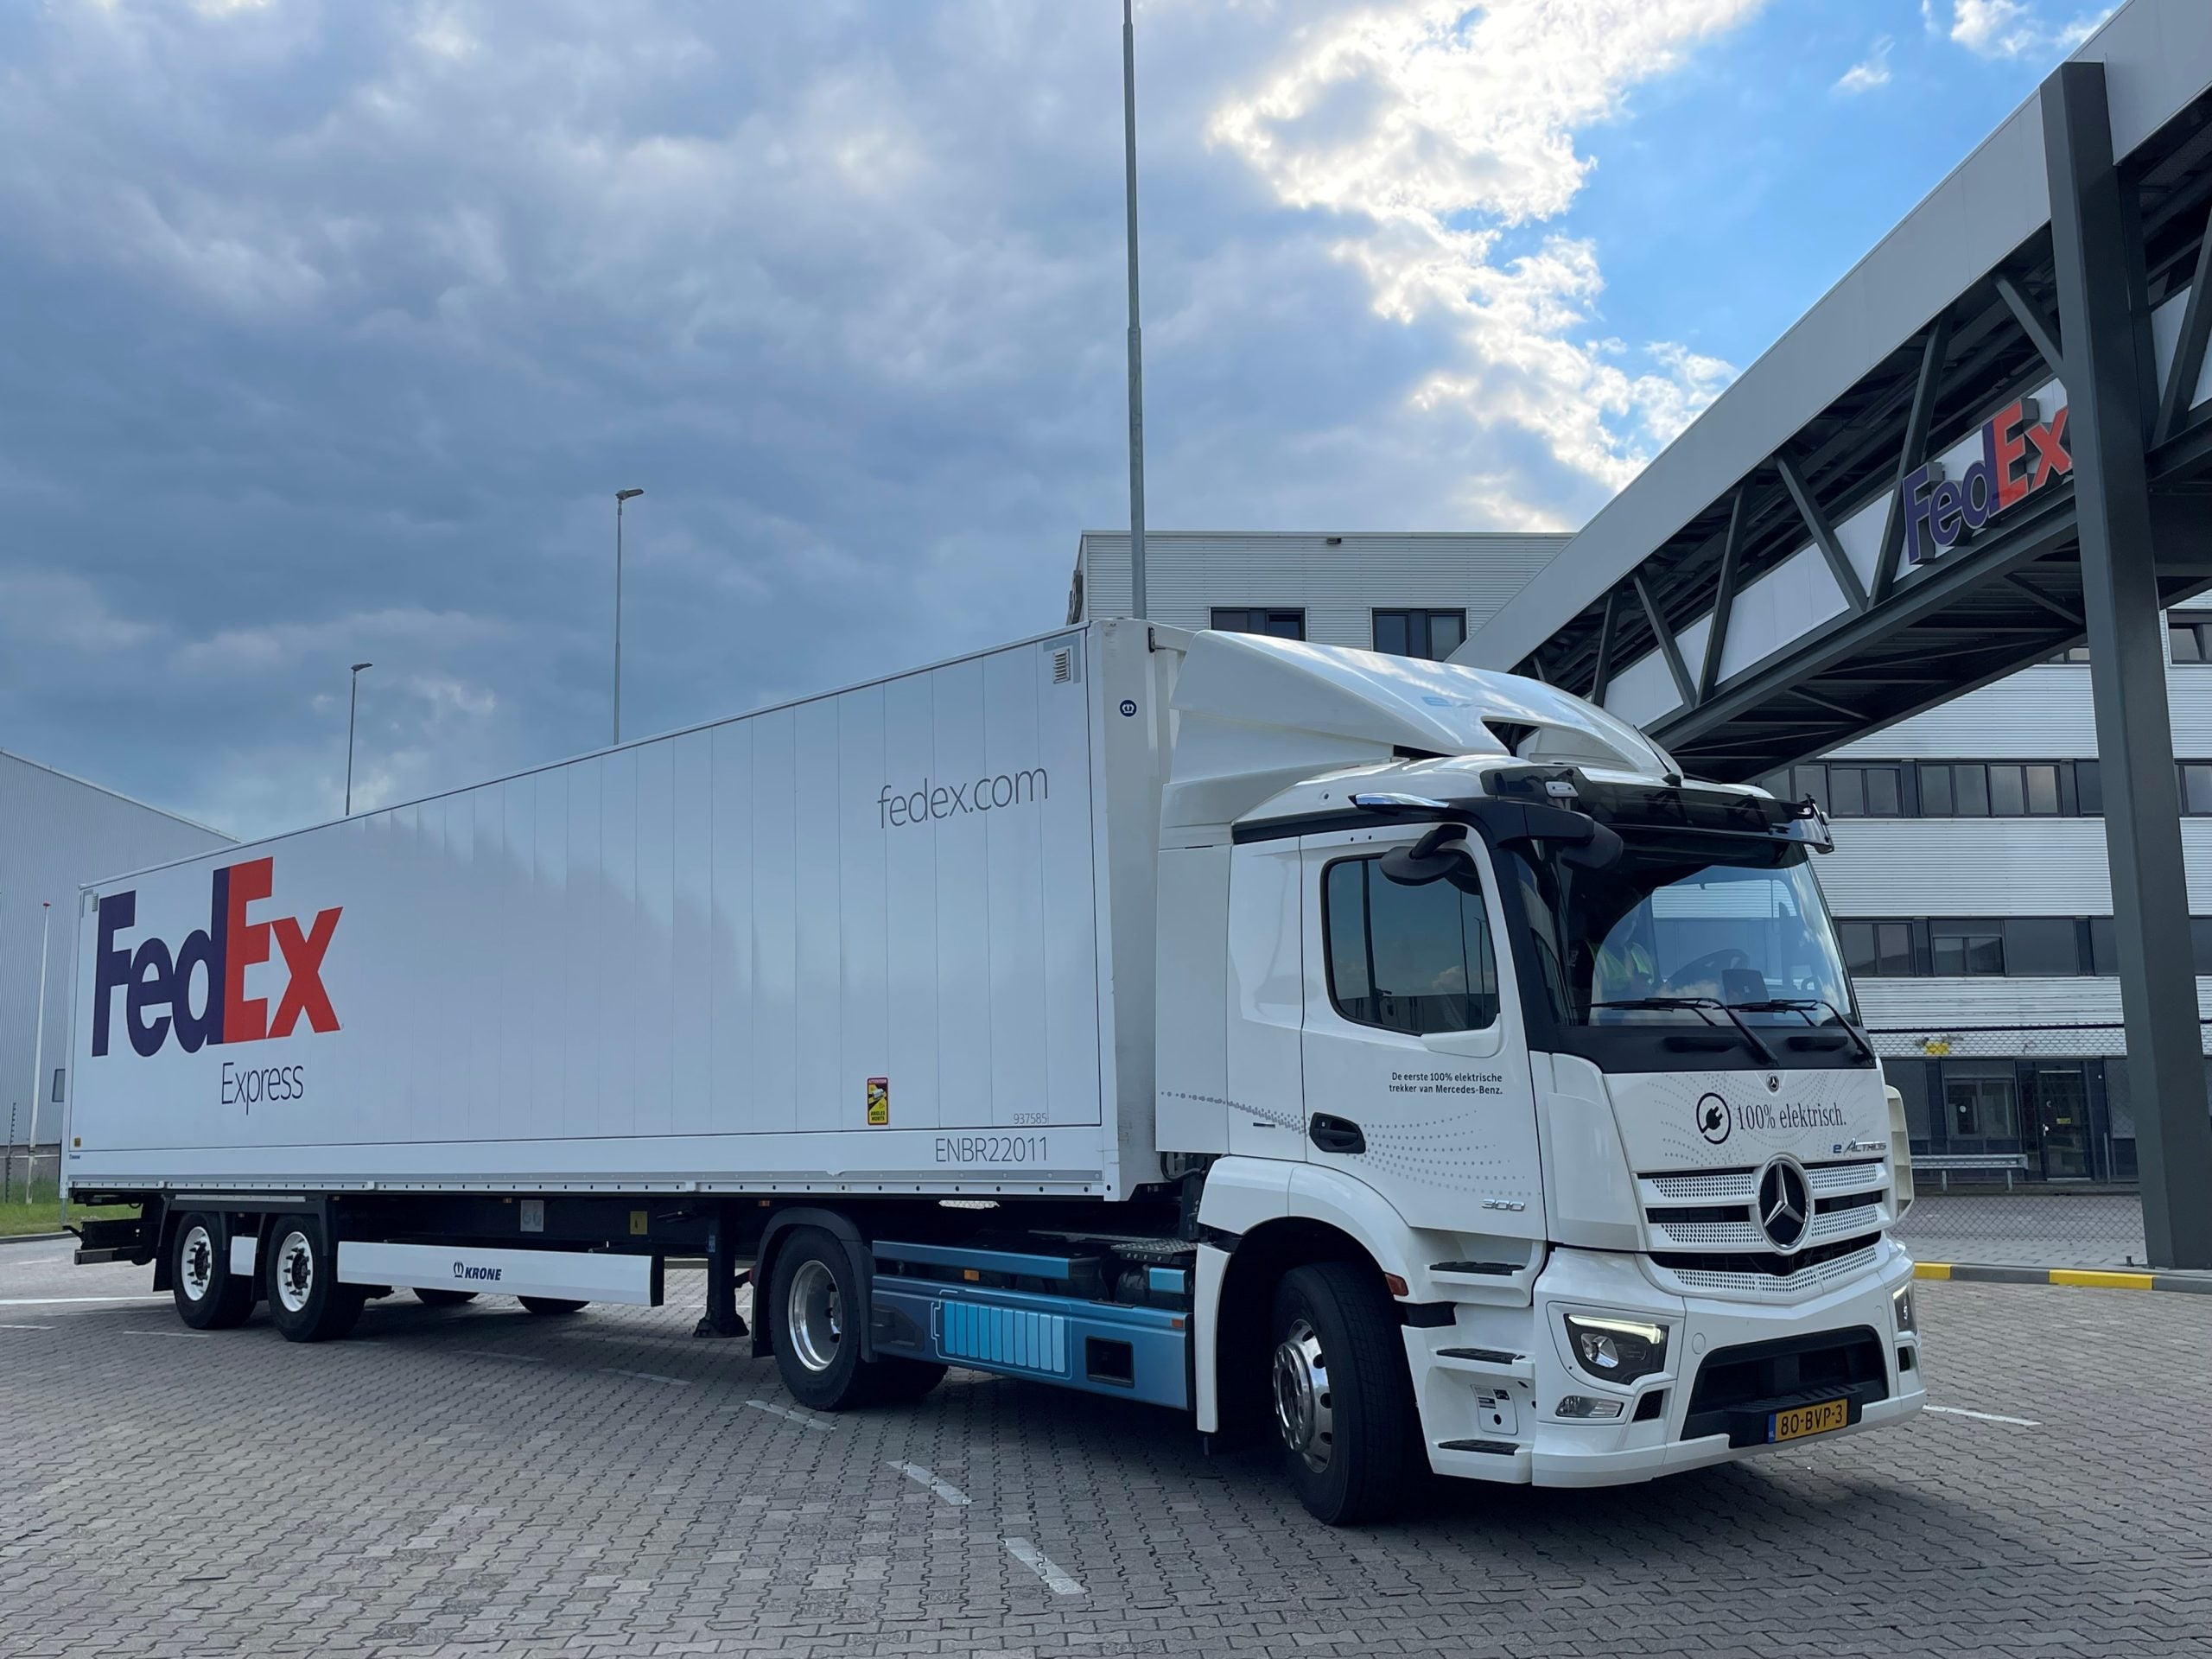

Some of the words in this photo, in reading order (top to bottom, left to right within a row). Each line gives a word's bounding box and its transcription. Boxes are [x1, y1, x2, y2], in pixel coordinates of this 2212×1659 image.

[1903, 400, 2072, 564] FedEx
[877, 768, 1048, 830] fedex.com
[92, 856, 343, 1057] FedEx
[221, 1062, 303, 1116] Express
[1389, 1084, 1417, 1093] trekker
[1435, 1084, 1503, 1095] Mercedes-Benz.
[1392, 1072, 1402, 1081] De
[1430, 1072, 1452, 1082] 100%
[1454, 1072, 1503, 1083] elektrische
[1013, 1113, 1047, 1125] 937585
[1738, 1103, 1776, 1130] 100%
[1779, 1103, 1847, 1128] elektrisch.
[936, 1136, 1047, 1162] ENBR22011
[1481, 1198, 1526, 1211] 300
[465, 1267, 502, 1281] KRONE
[1781, 1404, 1843, 1436] 80-BVP-3
